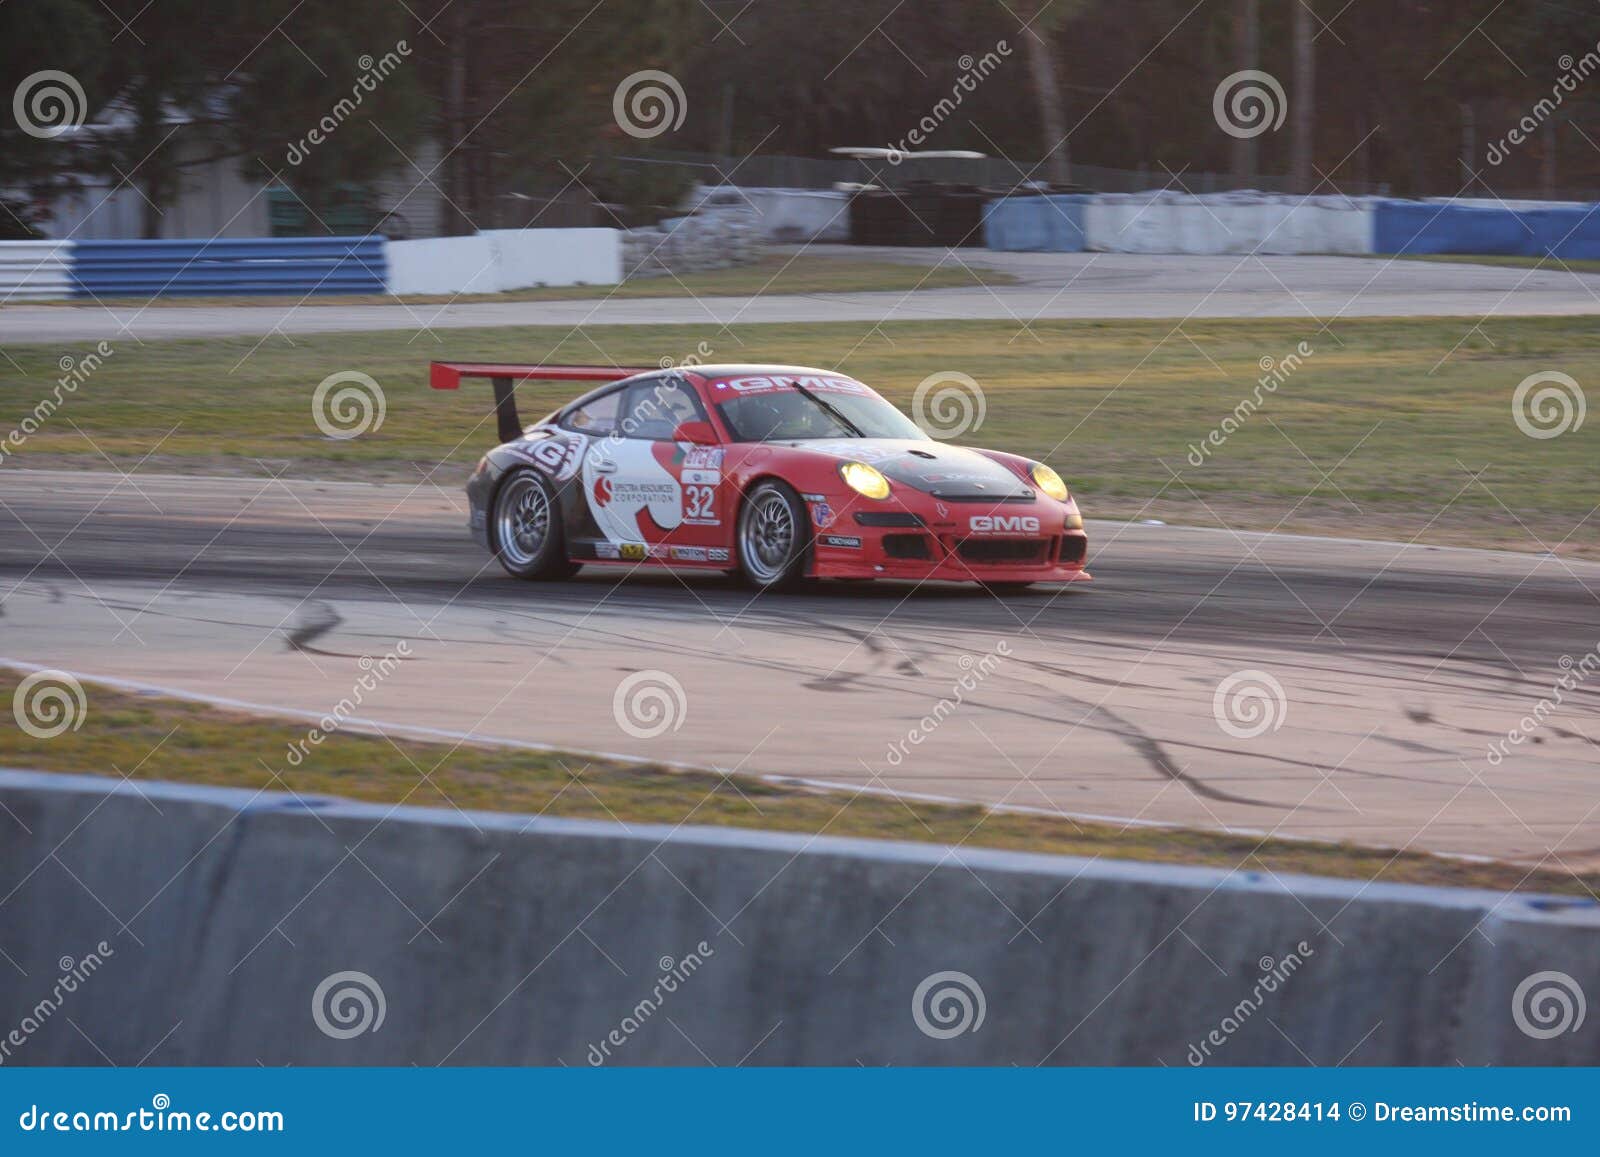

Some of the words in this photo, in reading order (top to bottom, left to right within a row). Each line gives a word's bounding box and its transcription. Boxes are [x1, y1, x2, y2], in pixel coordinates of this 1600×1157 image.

[615, 493, 673, 503] CORPORATION
[686, 485, 715, 518] 32
[969, 515, 1041, 531] GMG
